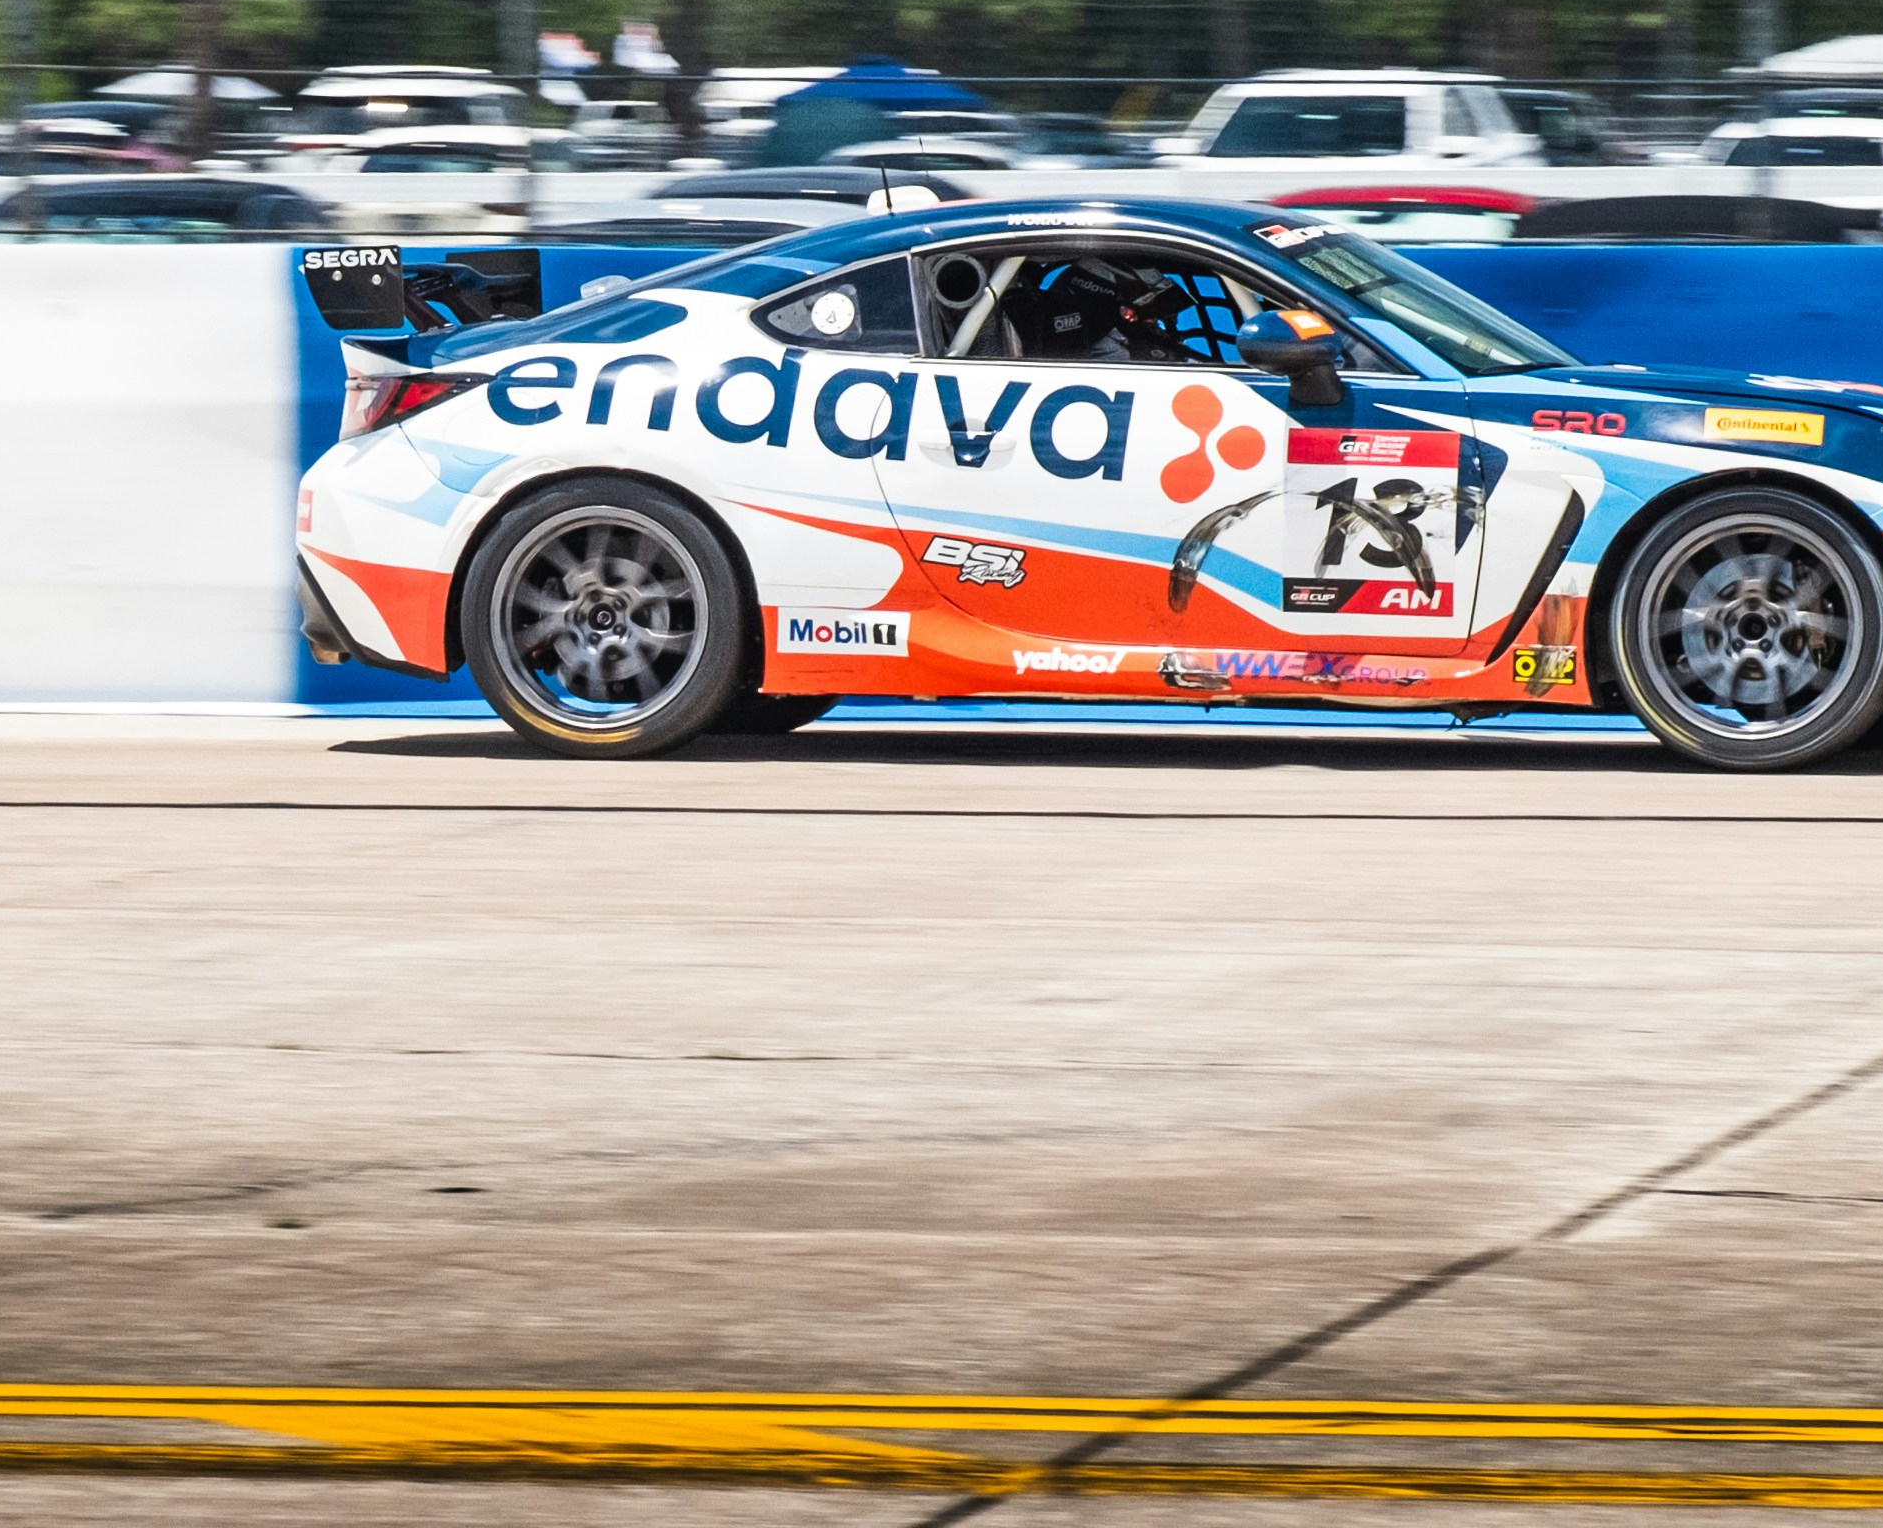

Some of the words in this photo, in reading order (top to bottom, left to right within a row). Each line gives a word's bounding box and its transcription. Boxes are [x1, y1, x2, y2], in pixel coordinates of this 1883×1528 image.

[304, 248, 397, 268] SEGRA
[486, 347, 1136, 482] endava
[1532, 409, 1627, 436] SRO
[1716, 417, 1798, 432] Continental
[1338, 441, 1370, 454] GR
[1315, 477, 1427, 568] 13
[1380, 587, 1442, 610] AM
[789, 618, 867, 644] Mobil
[1012, 646, 1127, 675] yahoo!
